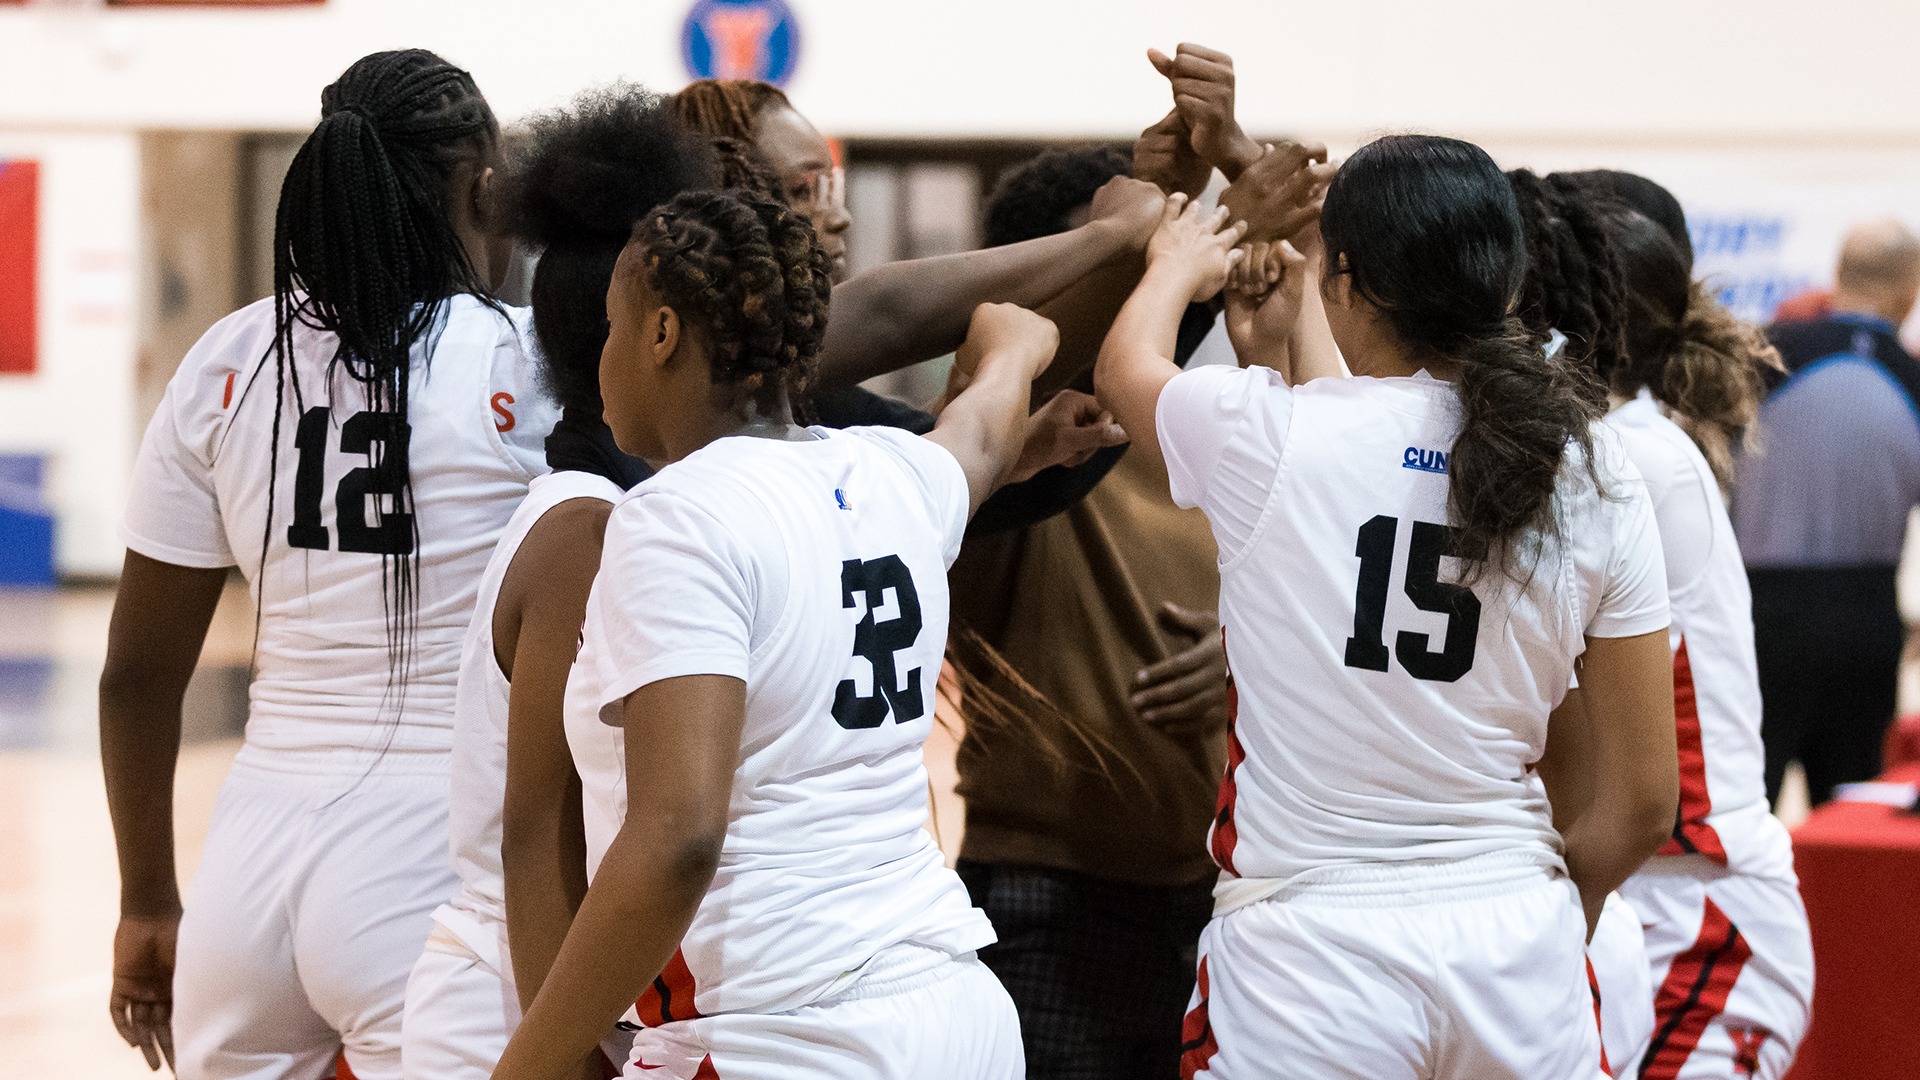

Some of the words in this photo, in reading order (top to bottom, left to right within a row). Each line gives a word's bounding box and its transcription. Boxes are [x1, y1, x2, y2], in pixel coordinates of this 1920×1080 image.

[287, 406, 414, 555] 12
[1403, 446, 1450, 470] CUN
[830, 554, 925, 730] 32
[1344, 514, 1489, 683] 15
